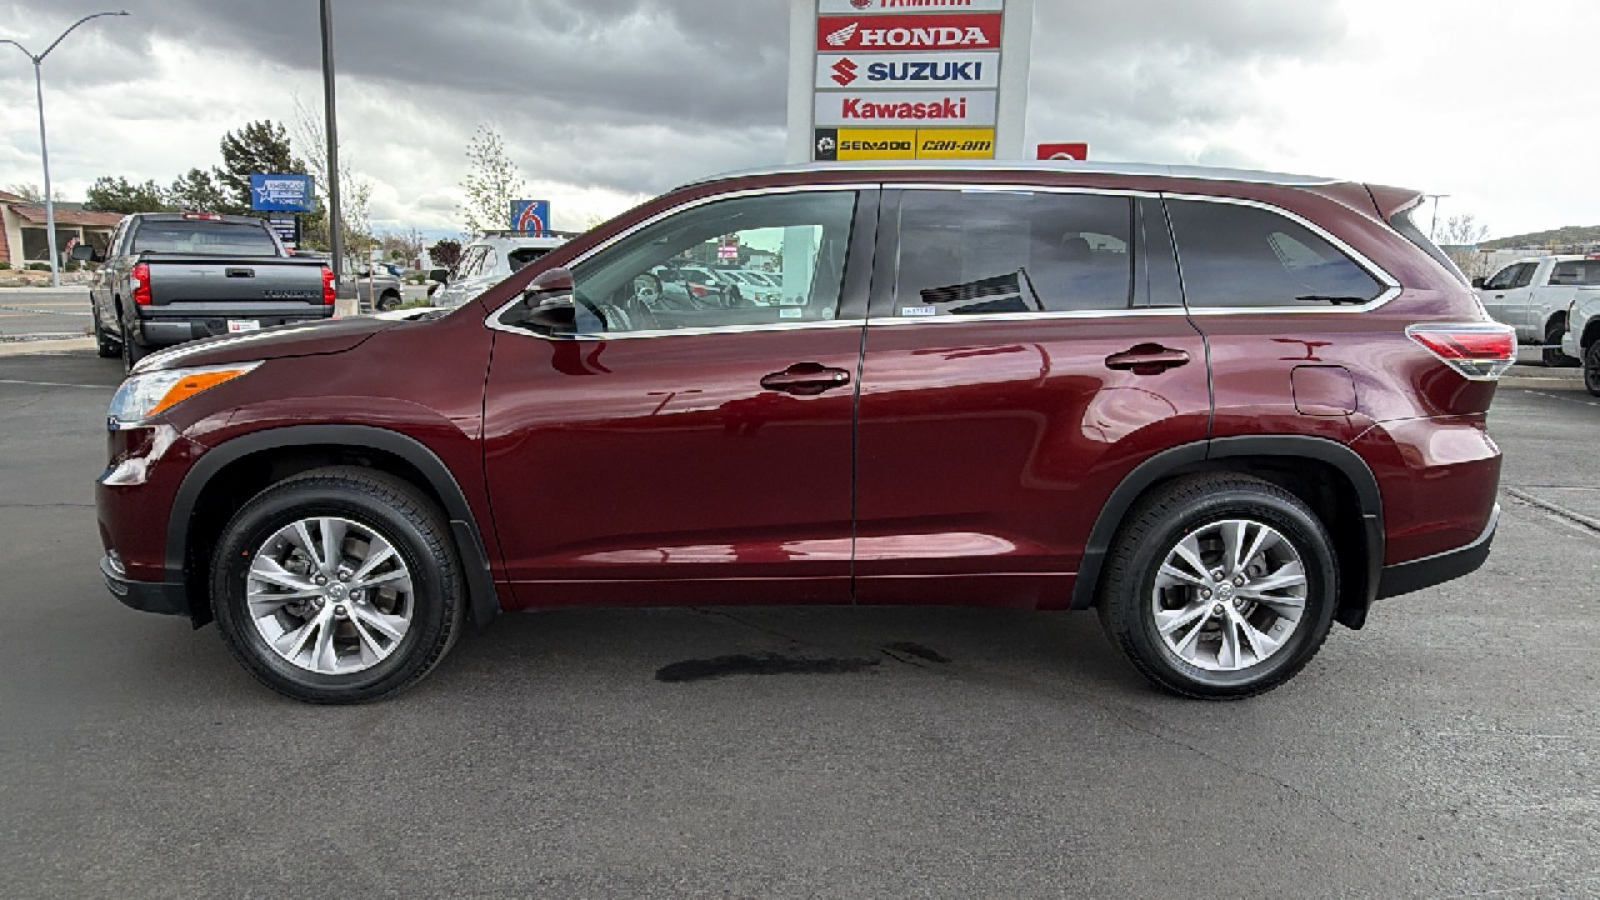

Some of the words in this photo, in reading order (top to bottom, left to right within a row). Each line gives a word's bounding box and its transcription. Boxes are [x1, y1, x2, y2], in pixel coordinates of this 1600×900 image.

[859, 26, 990, 46] HONDA
[867, 61, 982, 81] SUZUKI
[841, 97, 967, 119] Kawasaki
[518, 201, 543, 238] 6
